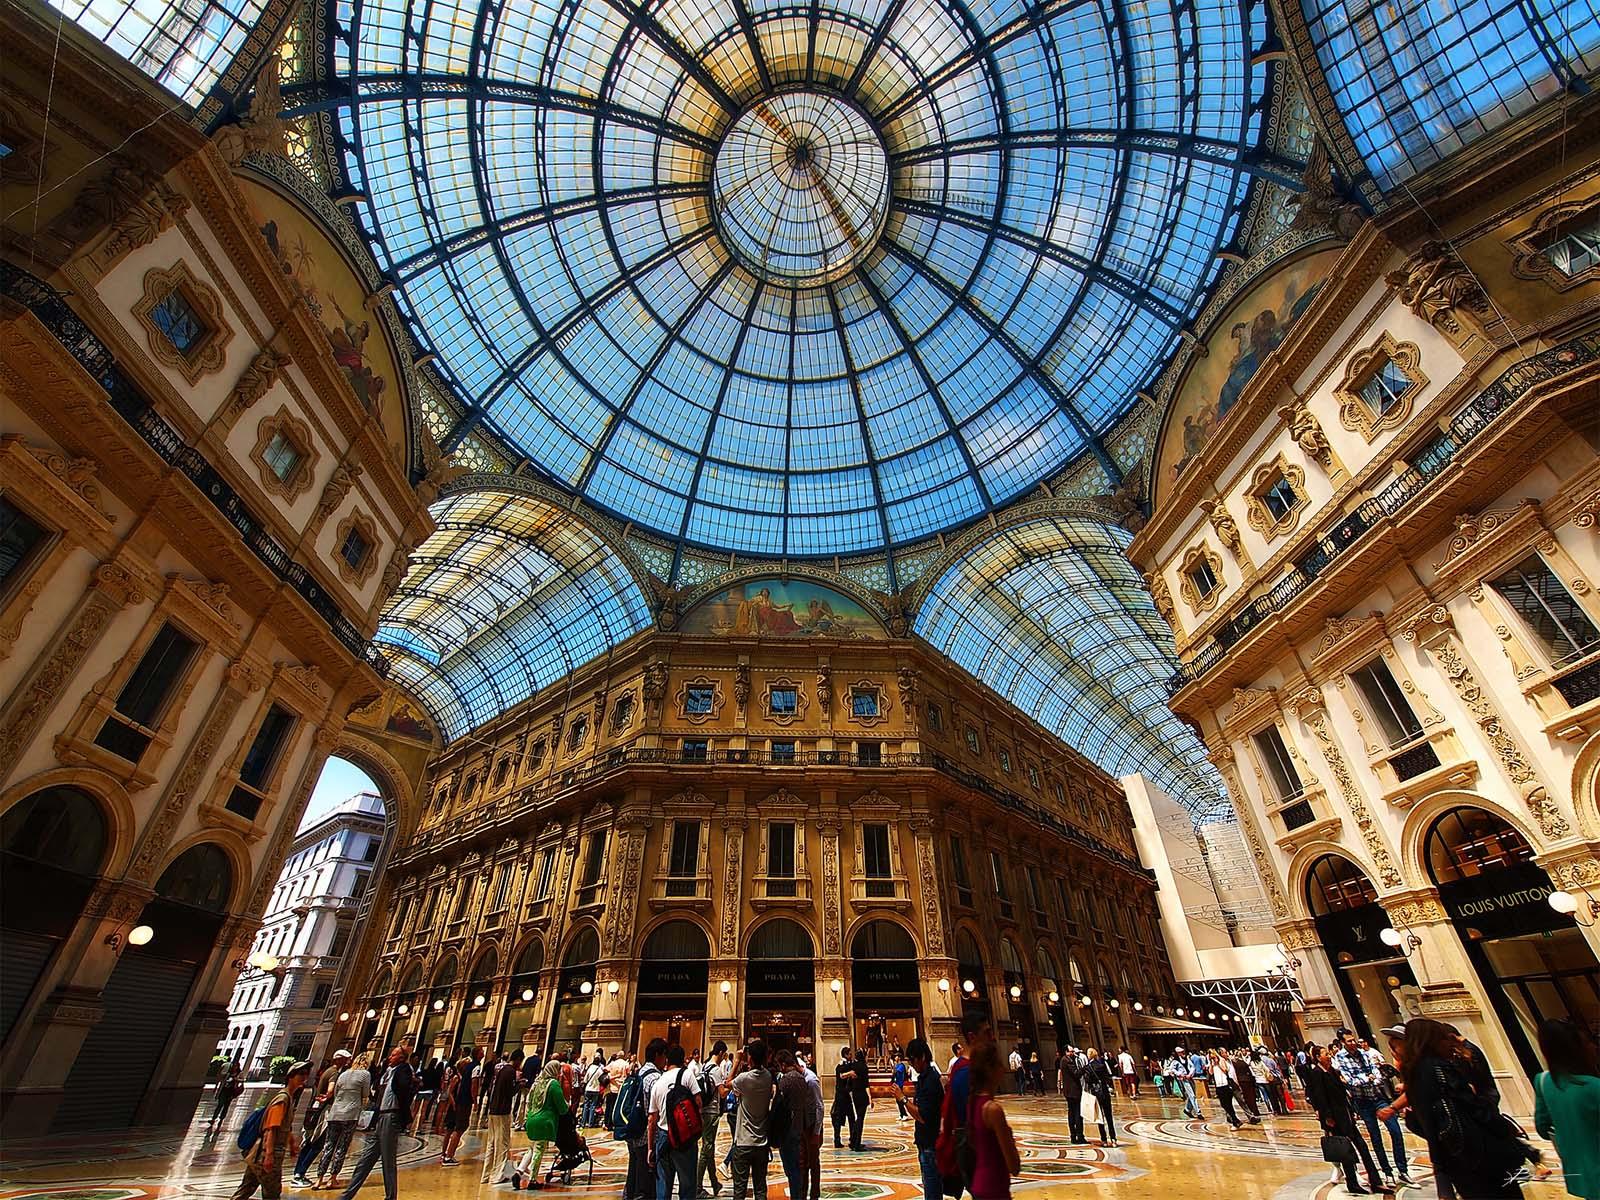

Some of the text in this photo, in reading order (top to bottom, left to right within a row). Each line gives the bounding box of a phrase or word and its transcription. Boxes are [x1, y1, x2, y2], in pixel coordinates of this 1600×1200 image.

[1457, 885, 1554, 917] LOUIS VUITTON
[657, 973, 690, 981] PRADA
[764, 973, 796, 981] PRADA
[869, 973, 900, 981] PRADA
